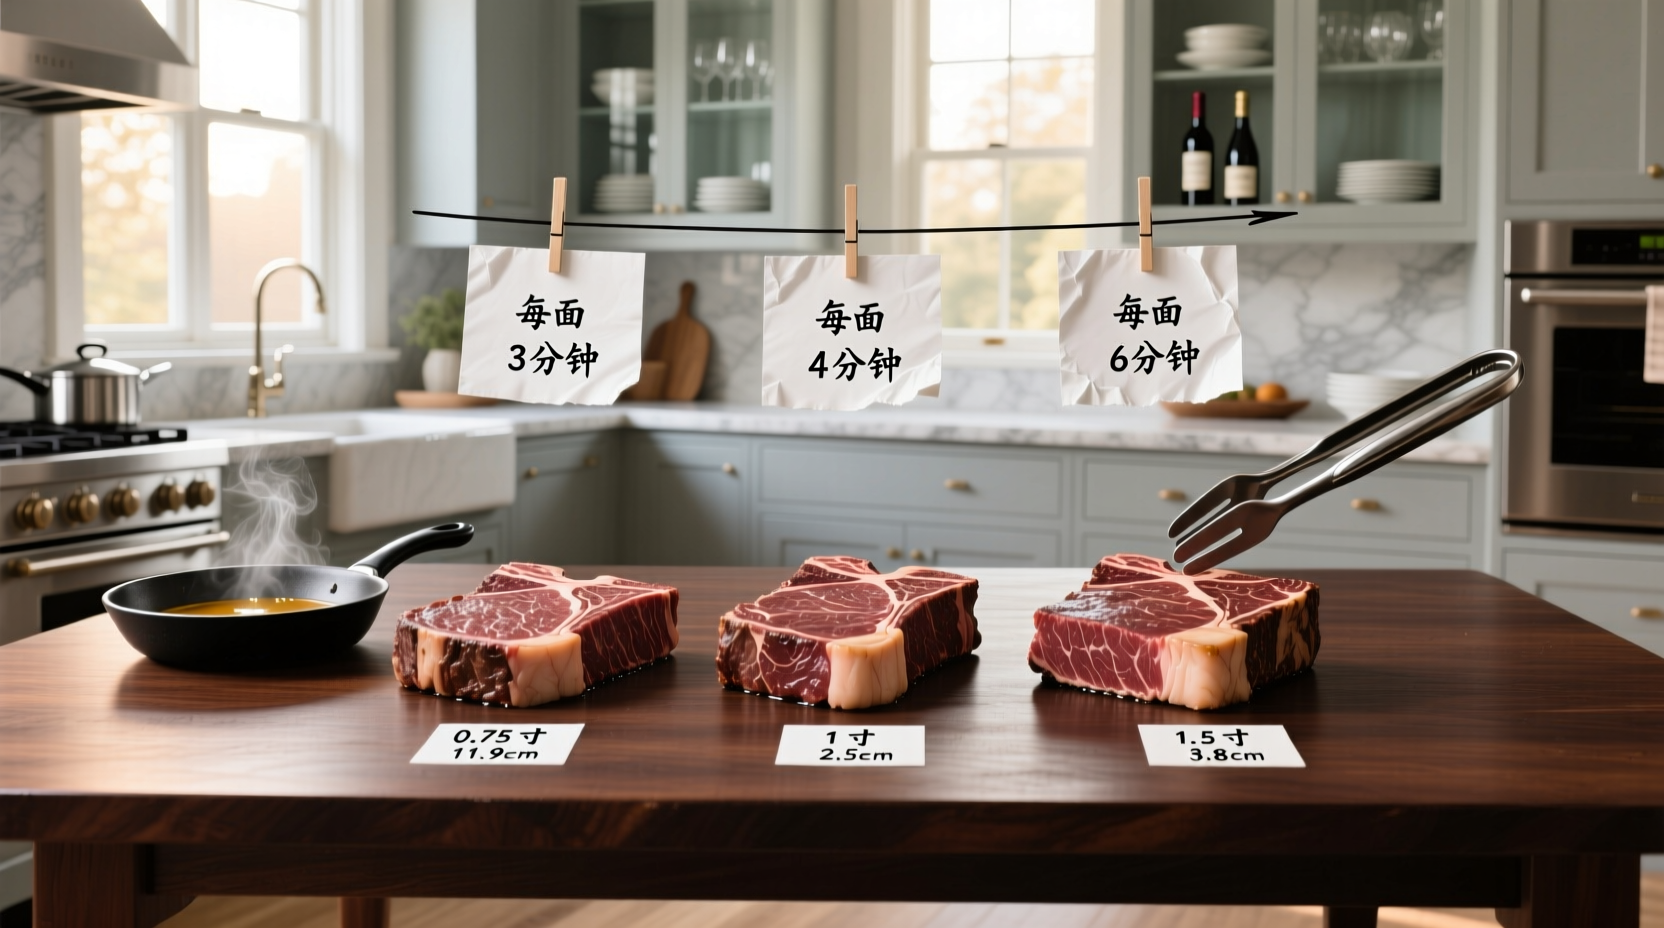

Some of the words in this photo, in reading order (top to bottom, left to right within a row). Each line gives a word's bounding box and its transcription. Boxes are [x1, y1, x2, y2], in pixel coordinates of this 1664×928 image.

[515, 294, 585, 332] 每面
[815, 299, 885, 337] 每面
[1113, 293, 1182, 331] 每面
[507, 340, 599, 379] 3分钟
[808, 346, 902, 383] 4分钟
[1109, 339, 1200, 376] 6分钟
[453, 729, 513, 744] 0.75
[519, 727, 547, 745] 寸
[826, 731, 837, 745] 1
[848, 728, 875, 747] 寸
[1175, 730, 1215, 745] 1.5
[1222, 728, 1249, 747] 寸
[453, 747, 539, 760] 11.9cm
[819, 748, 893, 761] 2.5cm
[1190, 748, 1265, 762] 3.8cm
